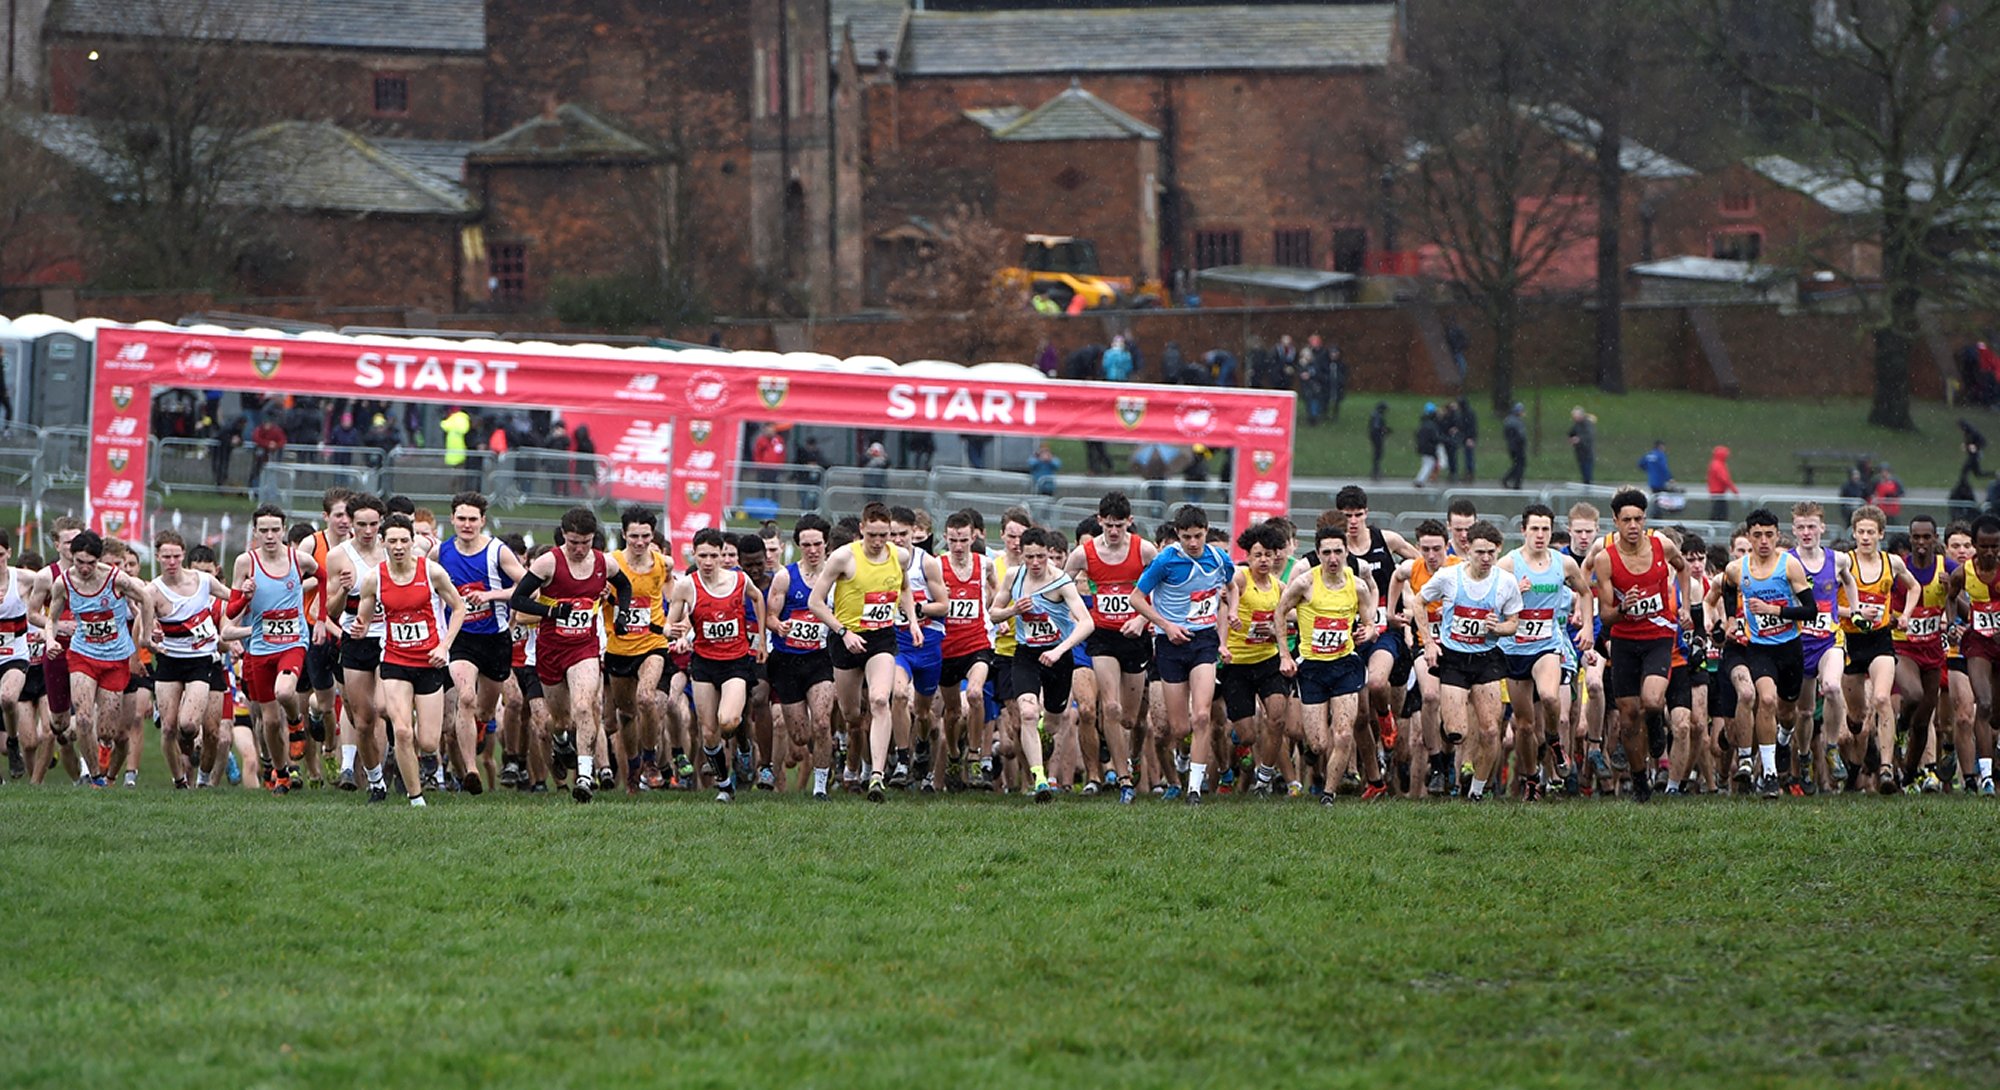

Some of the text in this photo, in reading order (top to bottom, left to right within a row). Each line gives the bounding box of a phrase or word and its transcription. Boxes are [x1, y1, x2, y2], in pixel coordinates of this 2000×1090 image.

[354, 352, 519, 395] START
[886, 384, 1047, 425] START
[868, 604, 891, 620] 469
[950, 600, 974, 618] 122
[1103, 596, 1129, 612] 205
[87, 621, 113, 637] 256
[268, 620, 294, 636] 253
[397, 624, 421, 640] 121
[708, 622, 735, 638] 409
[793, 622, 820, 640] 338
[1029, 622, 1056, 637] 242
[1462, 620, 1480, 636] 50
[1526, 621, 1544, 636] 97
[1912, 619, 1936, 634] 314
